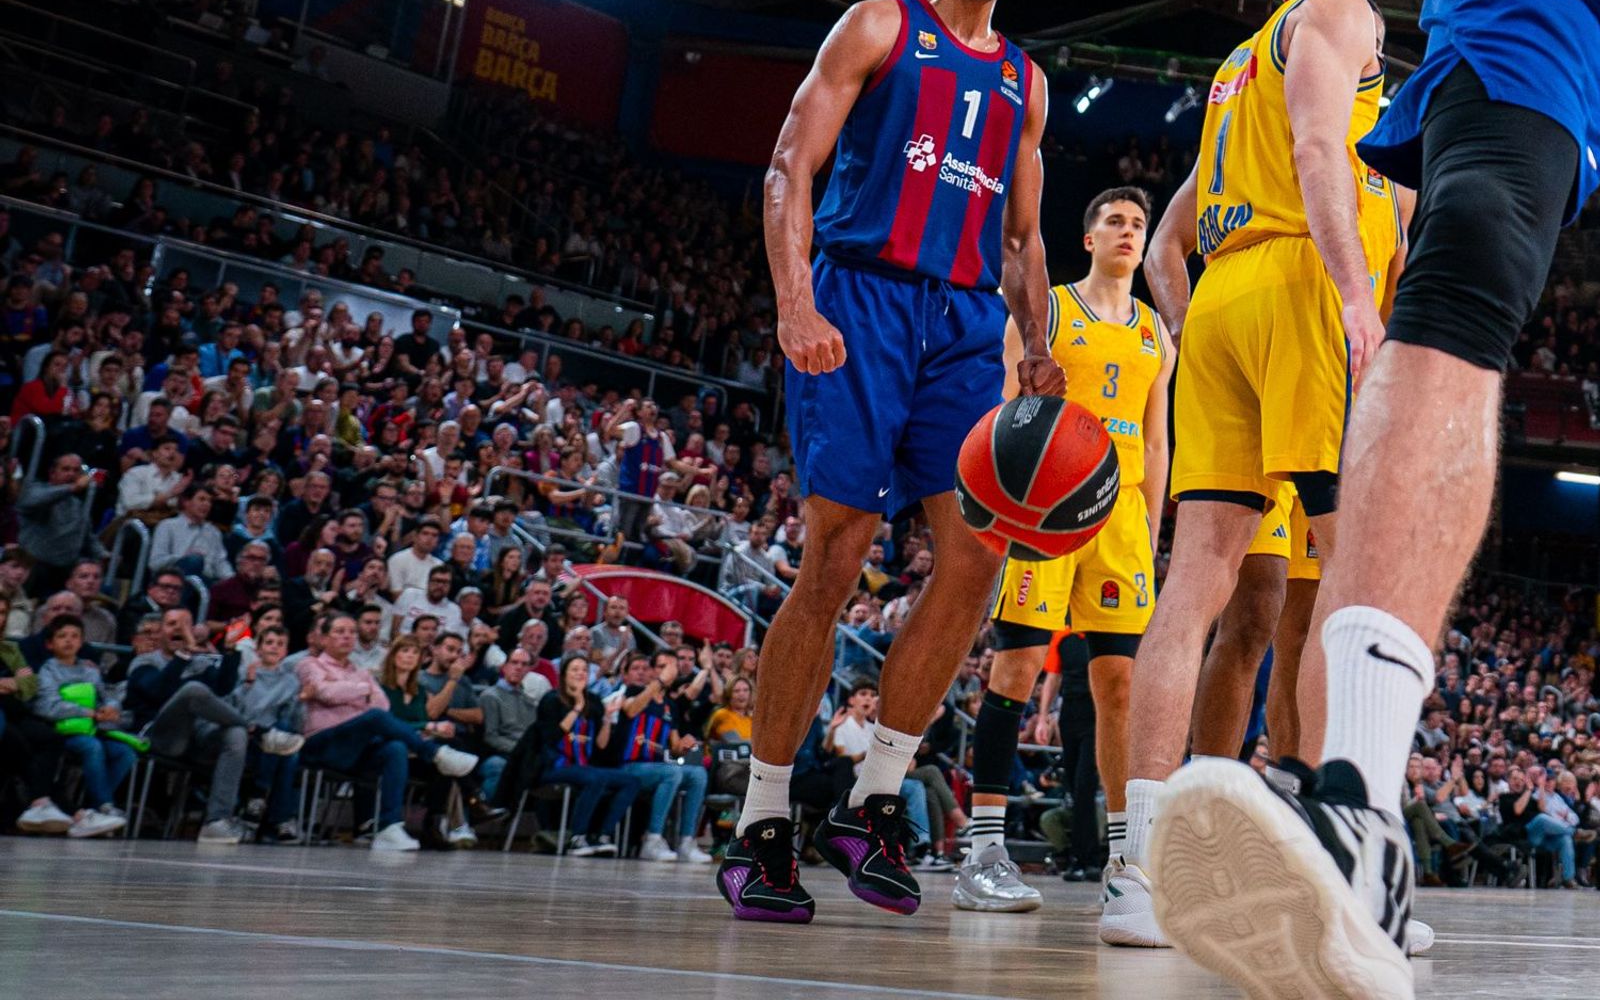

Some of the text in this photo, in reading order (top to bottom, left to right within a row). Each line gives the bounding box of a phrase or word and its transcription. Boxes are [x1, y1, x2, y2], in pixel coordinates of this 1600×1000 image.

[474, 46, 559, 104] BARÇA
[961, 89, 982, 140] 1
[1208, 109, 1233, 196] 1
[939, 165, 982, 198] Sanitàr
[1198, 201, 1253, 254] BERLIN
[1102, 363, 1119, 398] 3
[1134, 572, 1148, 608] 3
